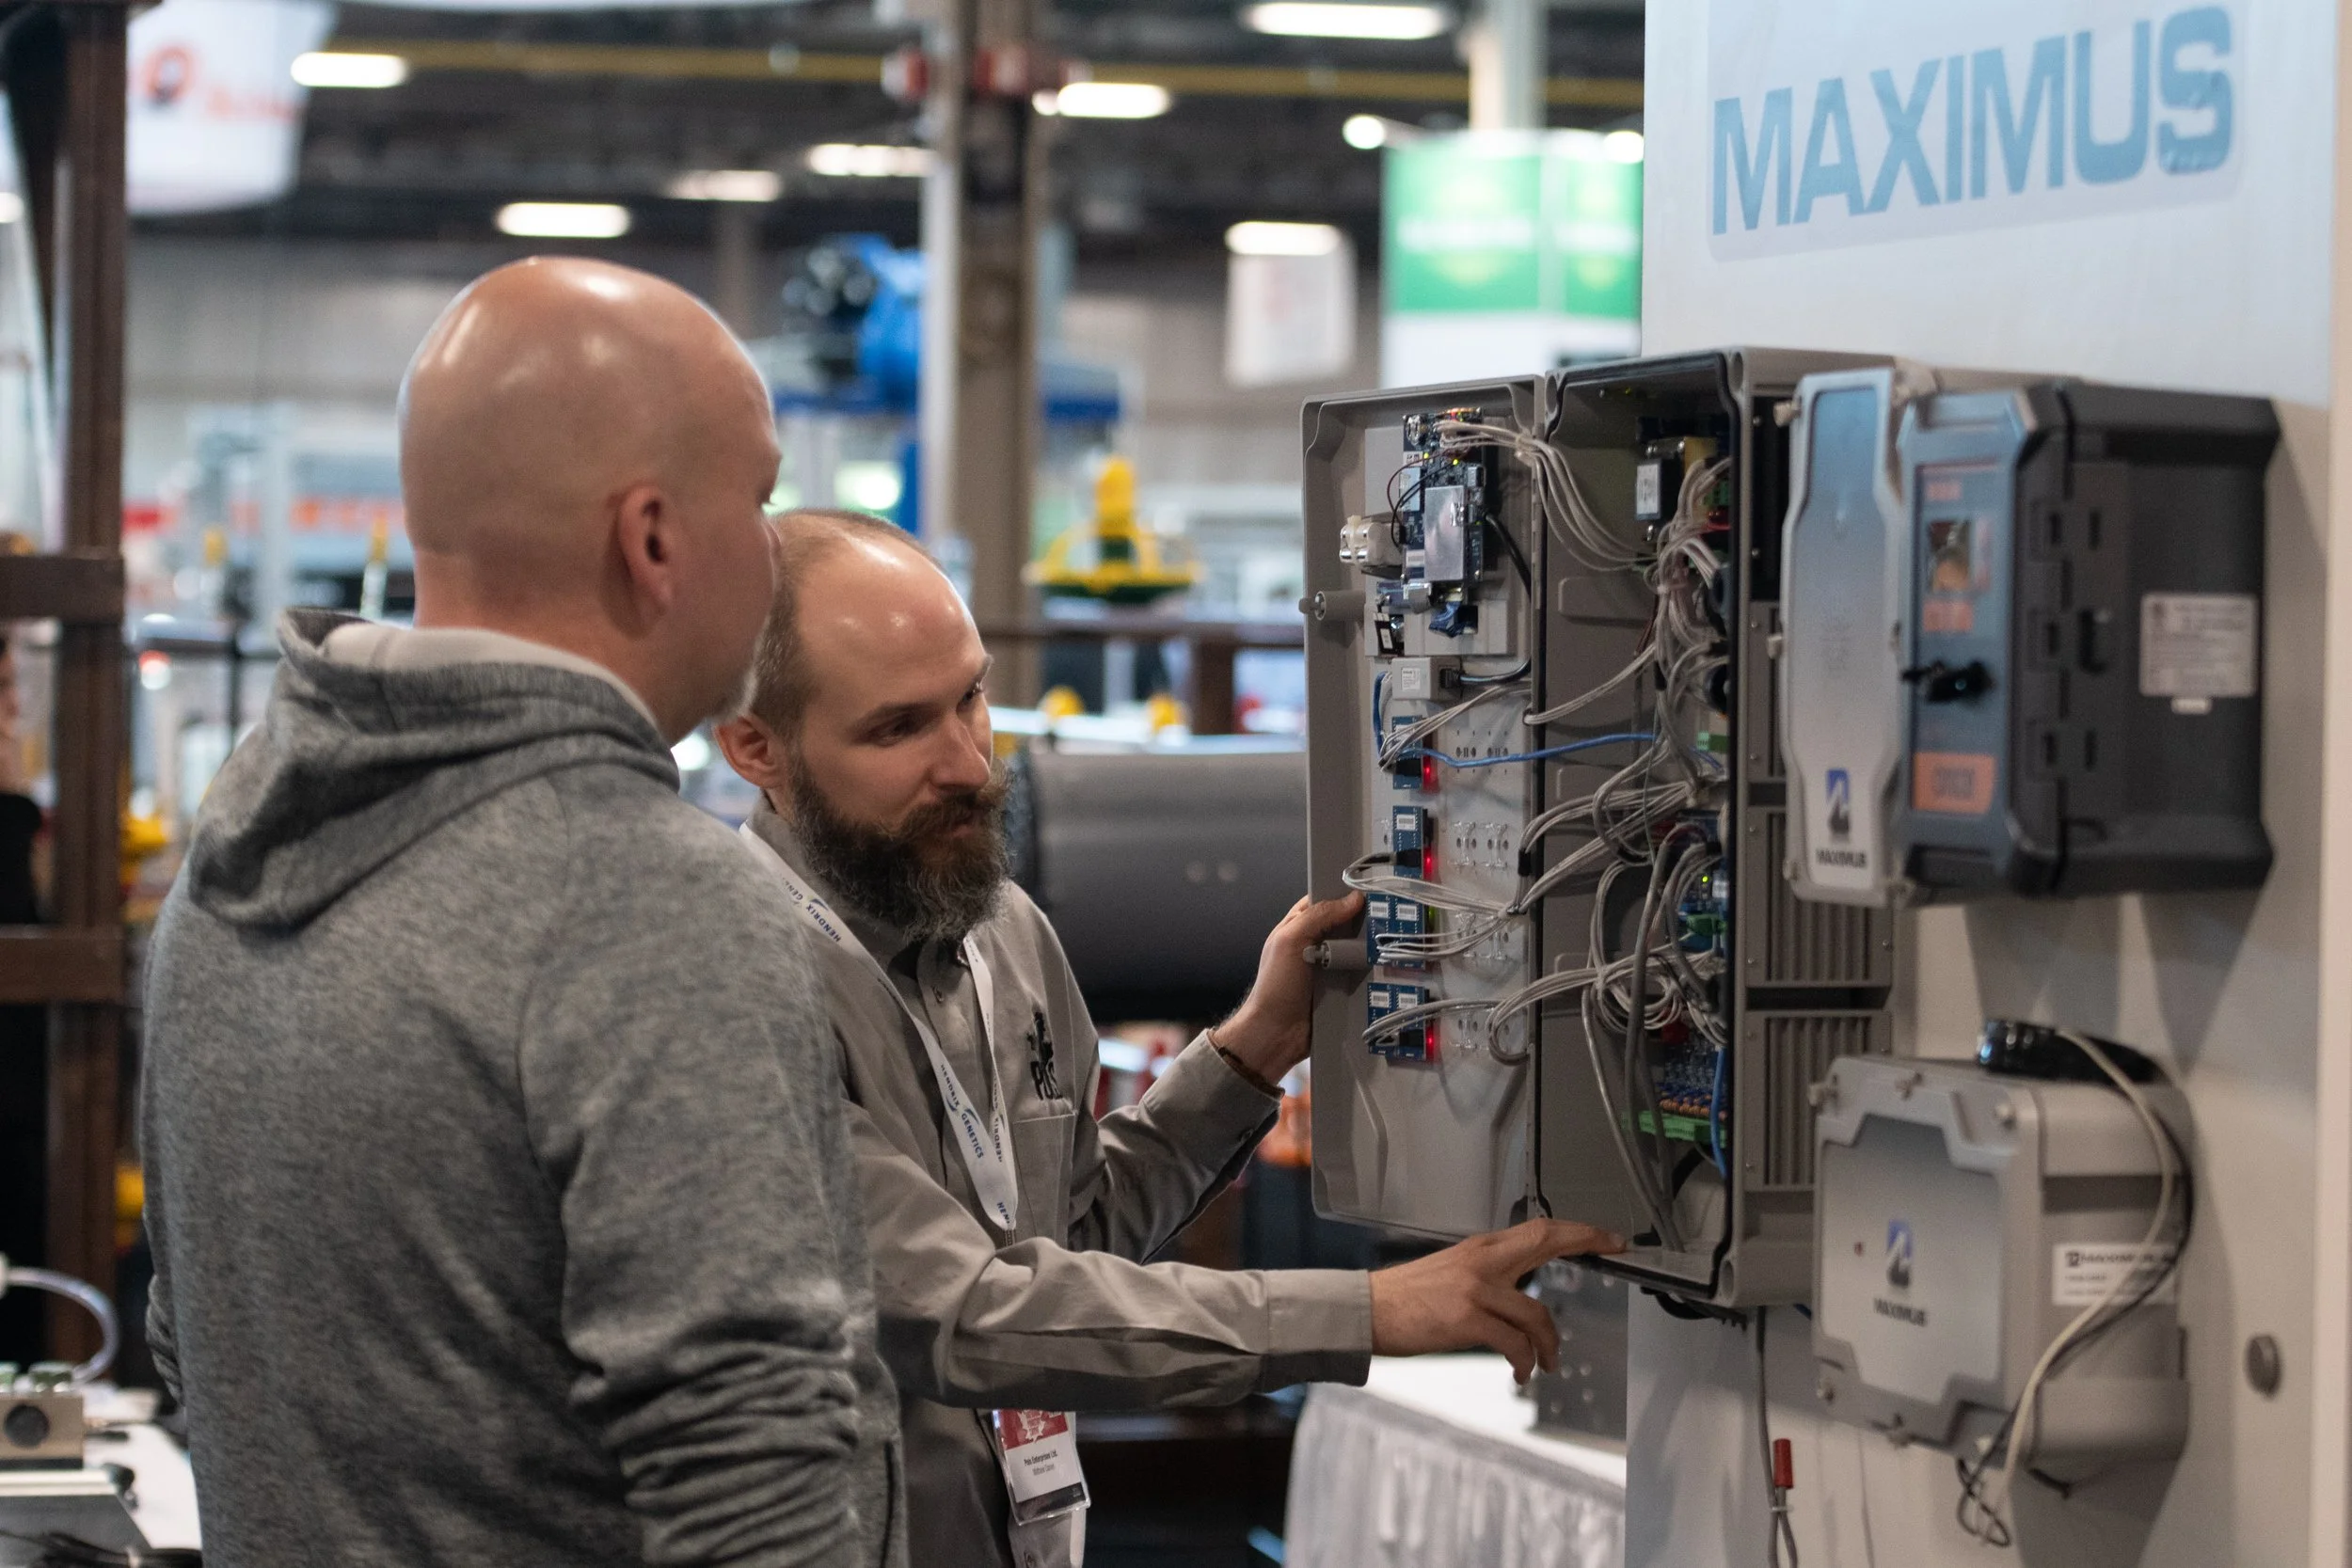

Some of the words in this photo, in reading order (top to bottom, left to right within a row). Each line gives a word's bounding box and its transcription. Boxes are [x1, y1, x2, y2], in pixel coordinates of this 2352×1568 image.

[1712, 6, 2233, 235] MAXIMUS
[806, 904, 841, 942] HENDRIX
[941, 1064, 960, 1107] HENDRIX
[961, 1113, 984, 1159] GENETICS
